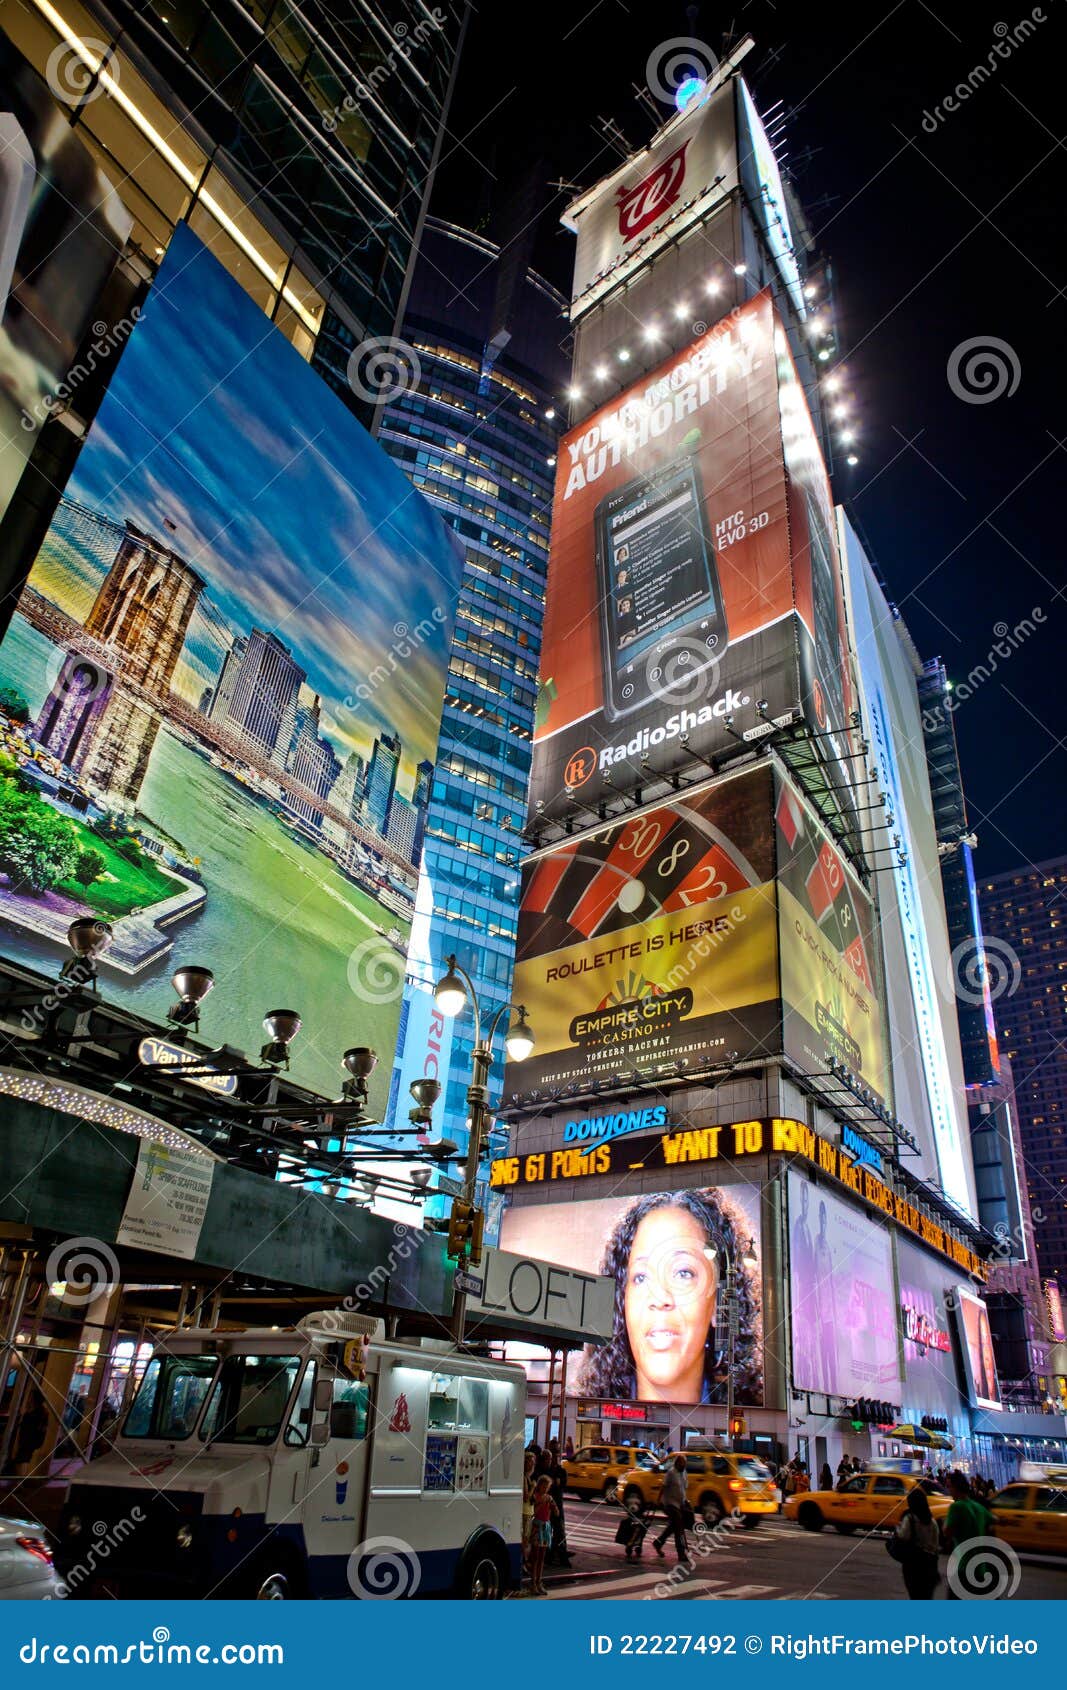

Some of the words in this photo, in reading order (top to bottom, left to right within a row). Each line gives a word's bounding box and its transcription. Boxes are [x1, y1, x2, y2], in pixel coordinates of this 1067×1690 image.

[645, 311, 758, 405] MOBL
[716, 510, 744, 536] HTC
[718, 525, 746, 551] EVO
[749, 512, 769, 533] 3D
[619, 817, 661, 858] 30
[657, 839, 690, 876] 8
[546, 942, 642, 983] ROULETTE
[647, 935, 664, 953] IS
[669, 915, 731, 946] HERE
[576, 1009, 639, 1036] EMPIRE
[603, 1024, 653, 1045] CASINO
[586, 1046, 625, 1062] YONKERS
[628, 1036, 671, 1053] RACEWAY
[525, 1156, 545, 1182] 61
[551, 1145, 611, 1180] POINTS
[662, 1127, 722, 1164] WANT
[732, 1121, 763, 1154] TO
[772, 1119, 815, 1163] KNOW
[481, 1252, 597, 1328] LOFT
